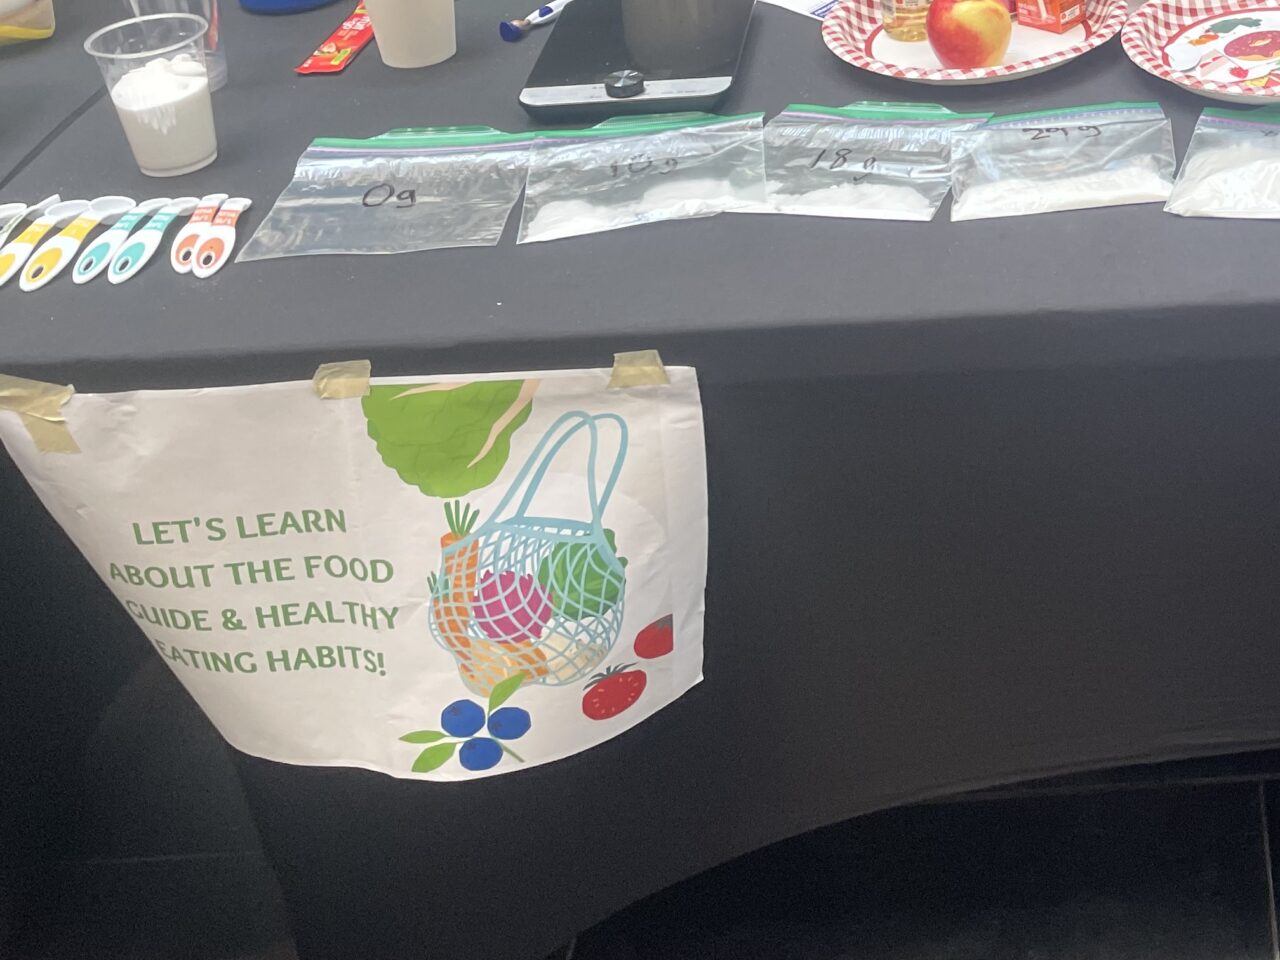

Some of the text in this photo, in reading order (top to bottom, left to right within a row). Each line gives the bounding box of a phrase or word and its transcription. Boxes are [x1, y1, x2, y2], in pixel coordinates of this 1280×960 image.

[131, 507, 348, 547] LET'S LEARN
[108, 554, 394, 588] ABOUT THE FOOD
[125, 600, 400, 632] GUIDE & HEALTHY
[155, 640, 387, 677] EATING HABITS!
